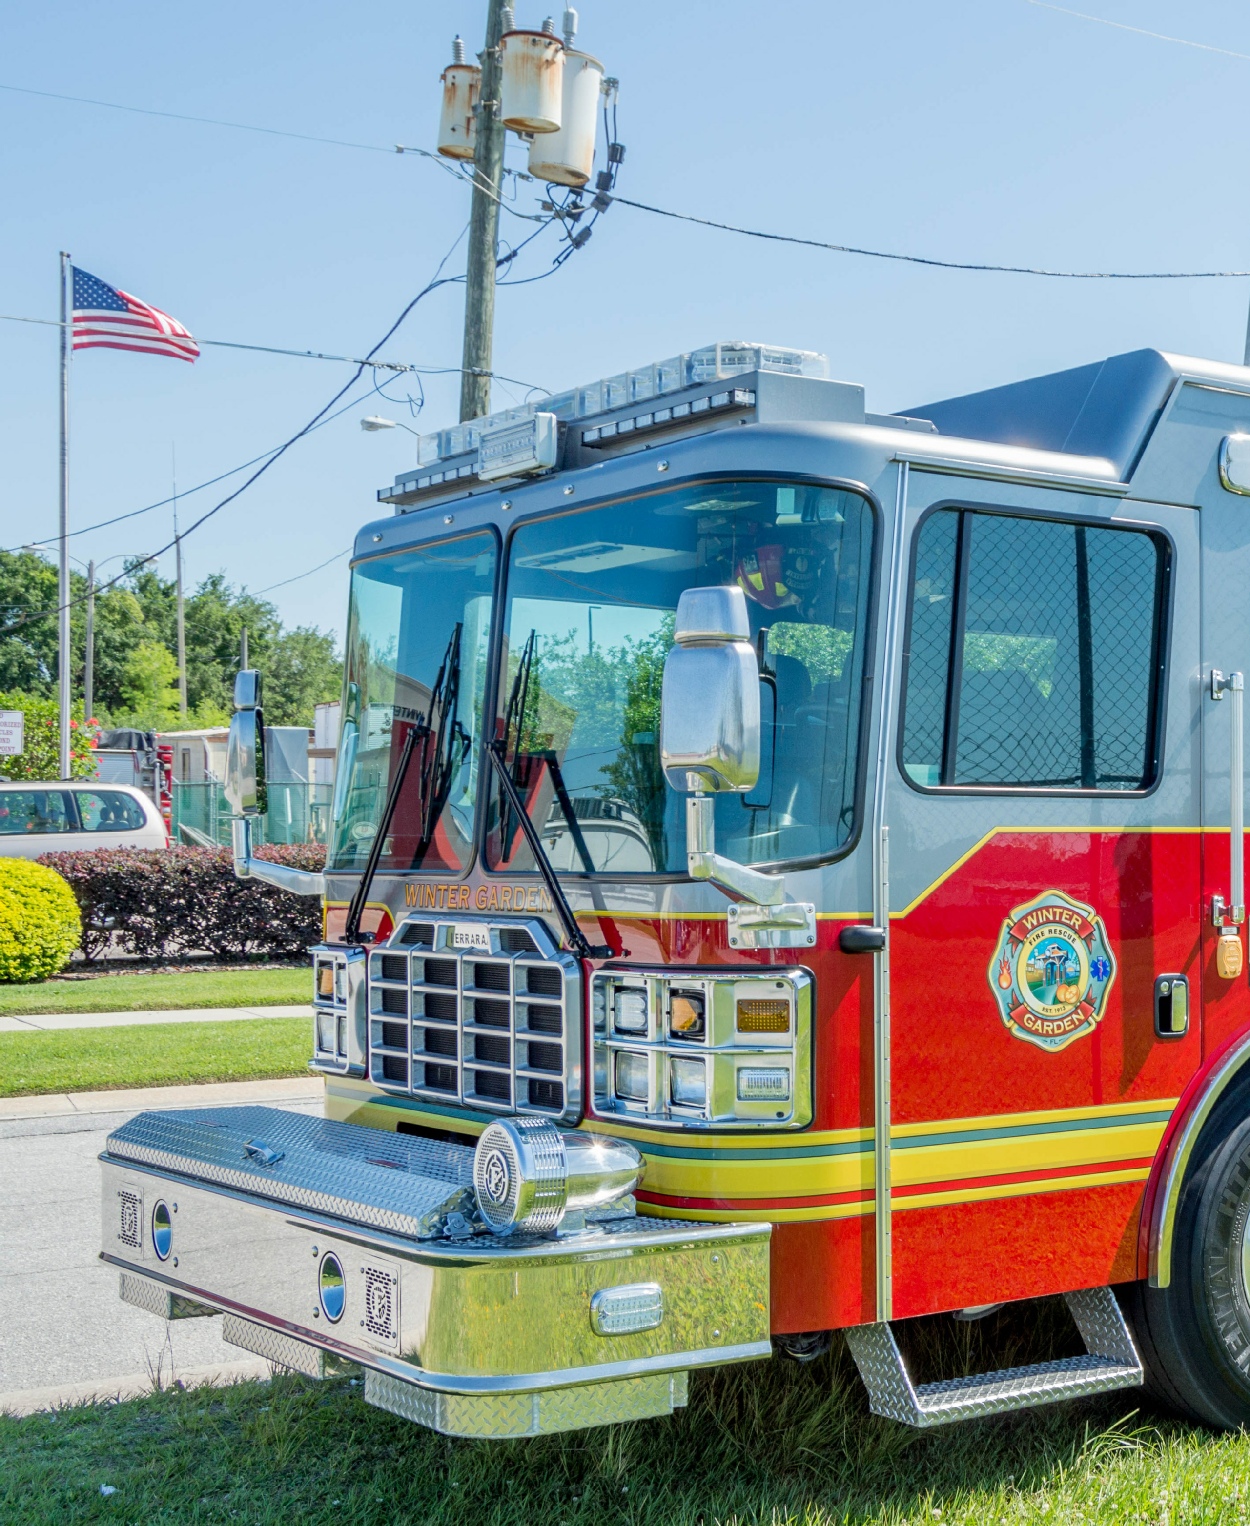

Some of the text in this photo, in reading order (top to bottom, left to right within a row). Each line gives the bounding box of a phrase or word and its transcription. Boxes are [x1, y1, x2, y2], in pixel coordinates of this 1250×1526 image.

[405, 883, 553, 913] WINTER GARDEN
[1022, 907, 1083, 931] WINTER
[1028, 928, 1077, 946] FIRE RESCUE
[1023, 1009, 1085, 1035] GARDEN
